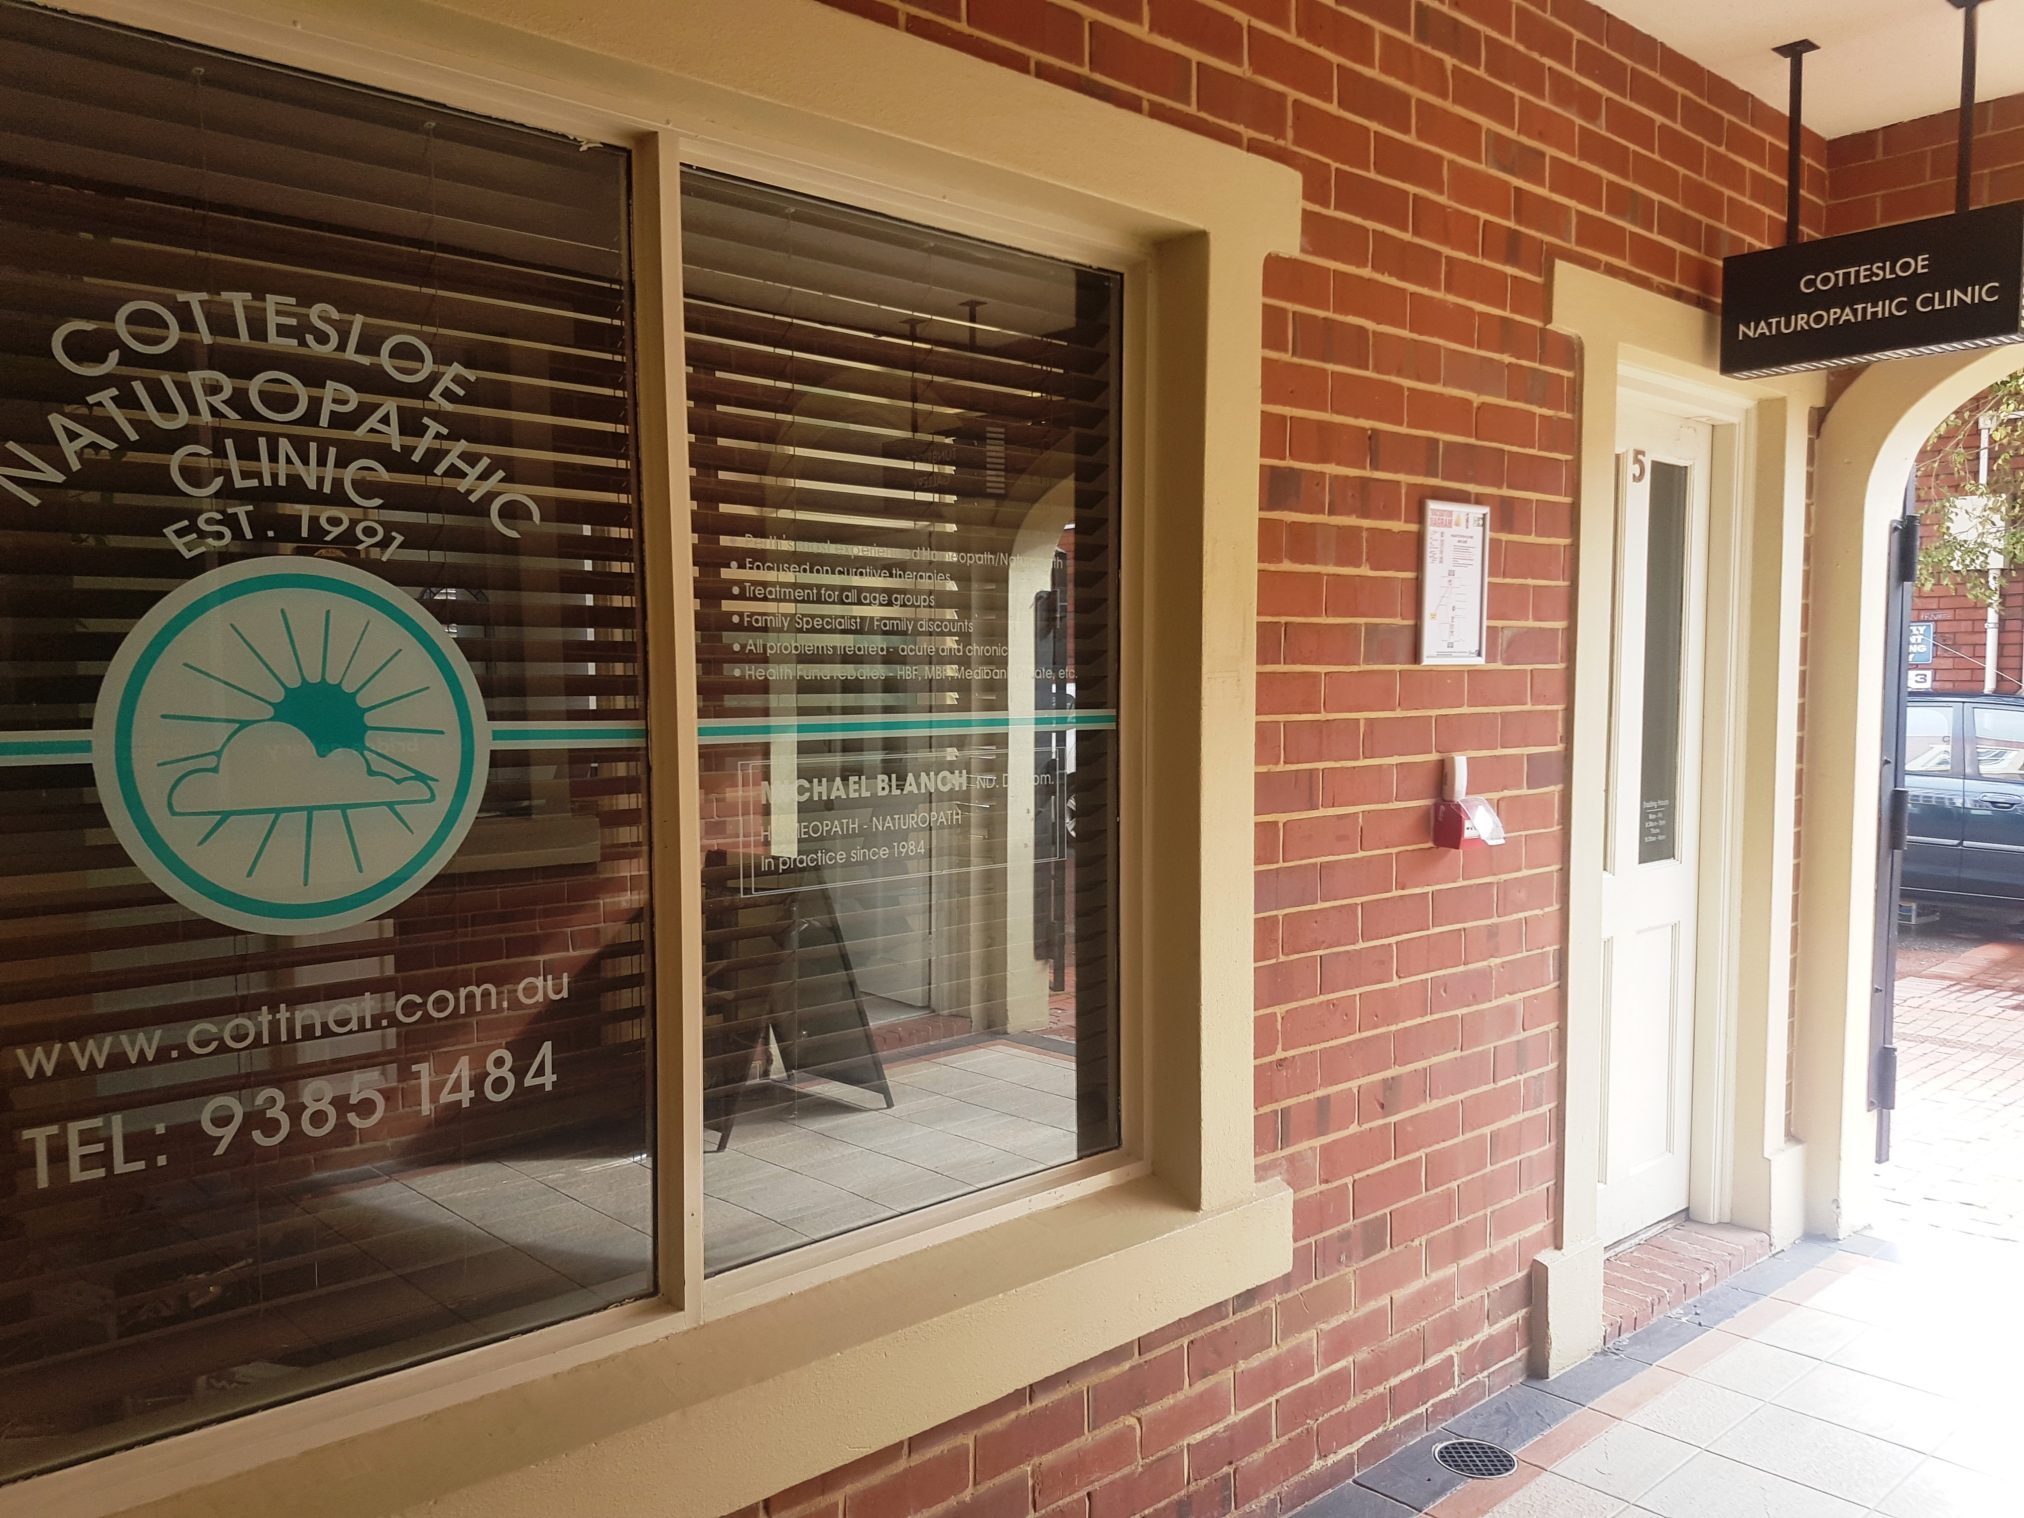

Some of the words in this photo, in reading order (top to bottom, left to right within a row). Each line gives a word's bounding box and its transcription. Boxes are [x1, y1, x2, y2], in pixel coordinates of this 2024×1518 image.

[1799, 254, 1930, 294] COTTESLOE
[1737, 297, 1909, 341] NATUROPATHIC
[1915, 282, 2000, 313] CLINIC
[51, 291, 477, 412] COTTESLOE
[0, 370, 540, 539] NATUROPATHIC
[169, 436, 390, 508] CLINIC
[1631, 448, 1647, 483] 5
[162, 505, 275, 560] EST.
[294, 504, 405, 563] 1991
[745, 558, 810, 574] Focused
[813, 566, 832, 576] on
[834, 566, 890, 579] curative
[892, 567, 951, 584] therapies
[743, 583, 817, 601] Treatment
[821, 587, 839, 602] for
[842, 589, 858, 604] all
[861, 594, 889, 607] age
[892, 594, 935, 607] groups
[743, 613, 791, 631] Family
[795, 614, 861, 632] Specialist
[864, 617, 870, 631] /
[874, 617, 914, 634] Family
[917, 618, 974, 633] discounts
[745, 639, 763, 654] All
[766, 640, 833, 657] problems
[837, 641, 887, 656] treated
[898, 643, 936, 656] acute
[939, 642, 963, 656] and
[965, 642, 1009, 657] chronic
[745, 665, 793, 681] Health
[955, 666, 1012, 681] Mediban
[1057, 667, 1079, 680] etc.
[761, 775, 870, 804] MCHAEL
[876, 769, 968, 797] BLANCH
[760, 818, 859, 842] HEOPATH
[872, 809, 962, 832] NATUROPATH
[760, 855, 775, 872] In
[779, 847, 847, 873] practice
[850, 844, 889, 862] since
[893, 840, 926, 858] 1984
[16, 971, 570, 1080] www.cottnat.com.au
[21, 1114, 168, 1189] TEL:
[200, 1071, 387, 1156] 9385
[411, 1040, 558, 1116] 1484
